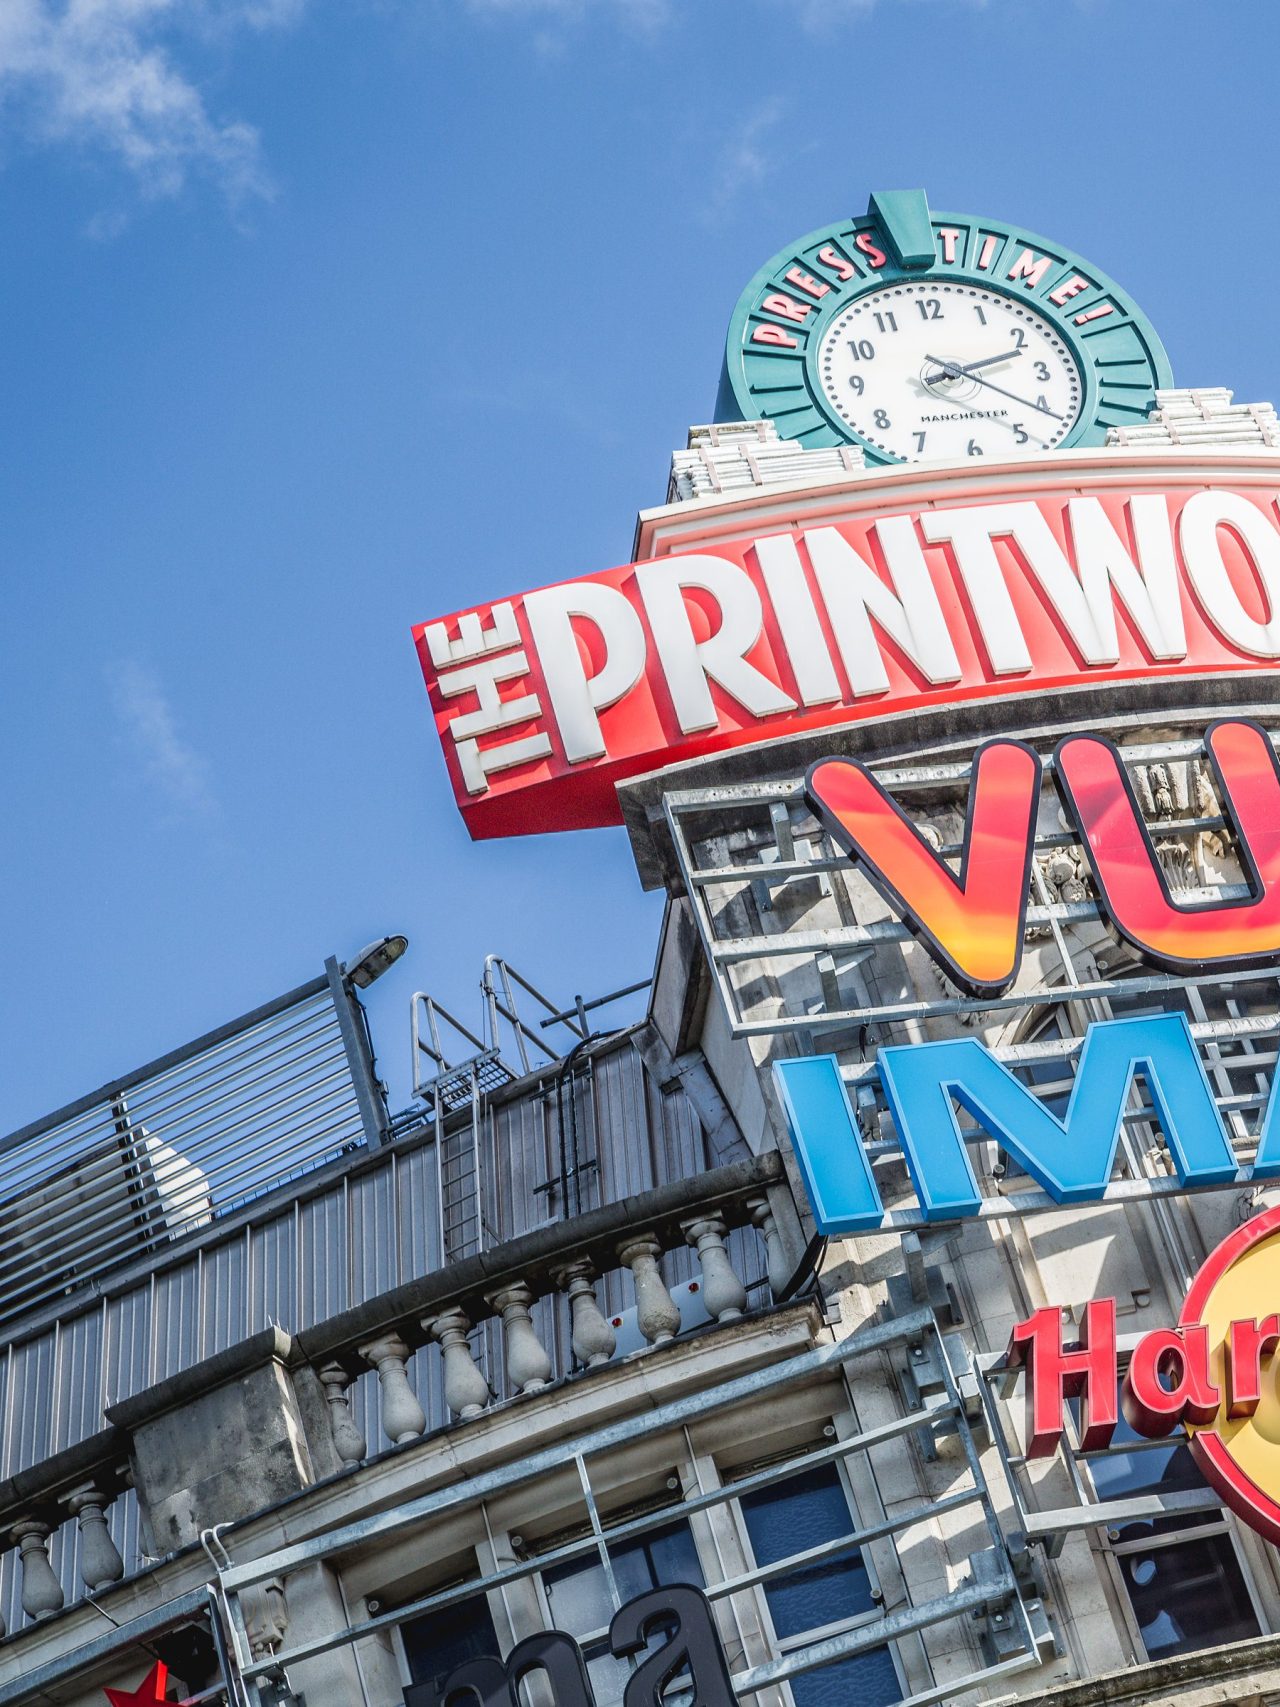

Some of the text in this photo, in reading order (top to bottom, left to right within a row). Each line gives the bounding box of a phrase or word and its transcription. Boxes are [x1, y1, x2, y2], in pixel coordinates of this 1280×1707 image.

[752, 227, 1115, 349] PRESS TIME!
[915, 298, 945, 321] 12
[973, 305, 988, 326] 1
[873, 311, 899, 333] 11
[1010, 327, 1029, 349] 2
[847, 339, 875, 361] 10
[1033, 361, 1051, 382] 3
[849, 375, 865, 396] 9
[1035, 394, 1051, 413] 4
[873, 408, 892, 430] 8
[920, 409, 1009, 424] MANCHESTER
[912, 431, 927, 453] 7
[1012, 422, 1030, 444] 5
[967, 438, 984, 456] 6
[424, 600, 553, 797] THE
